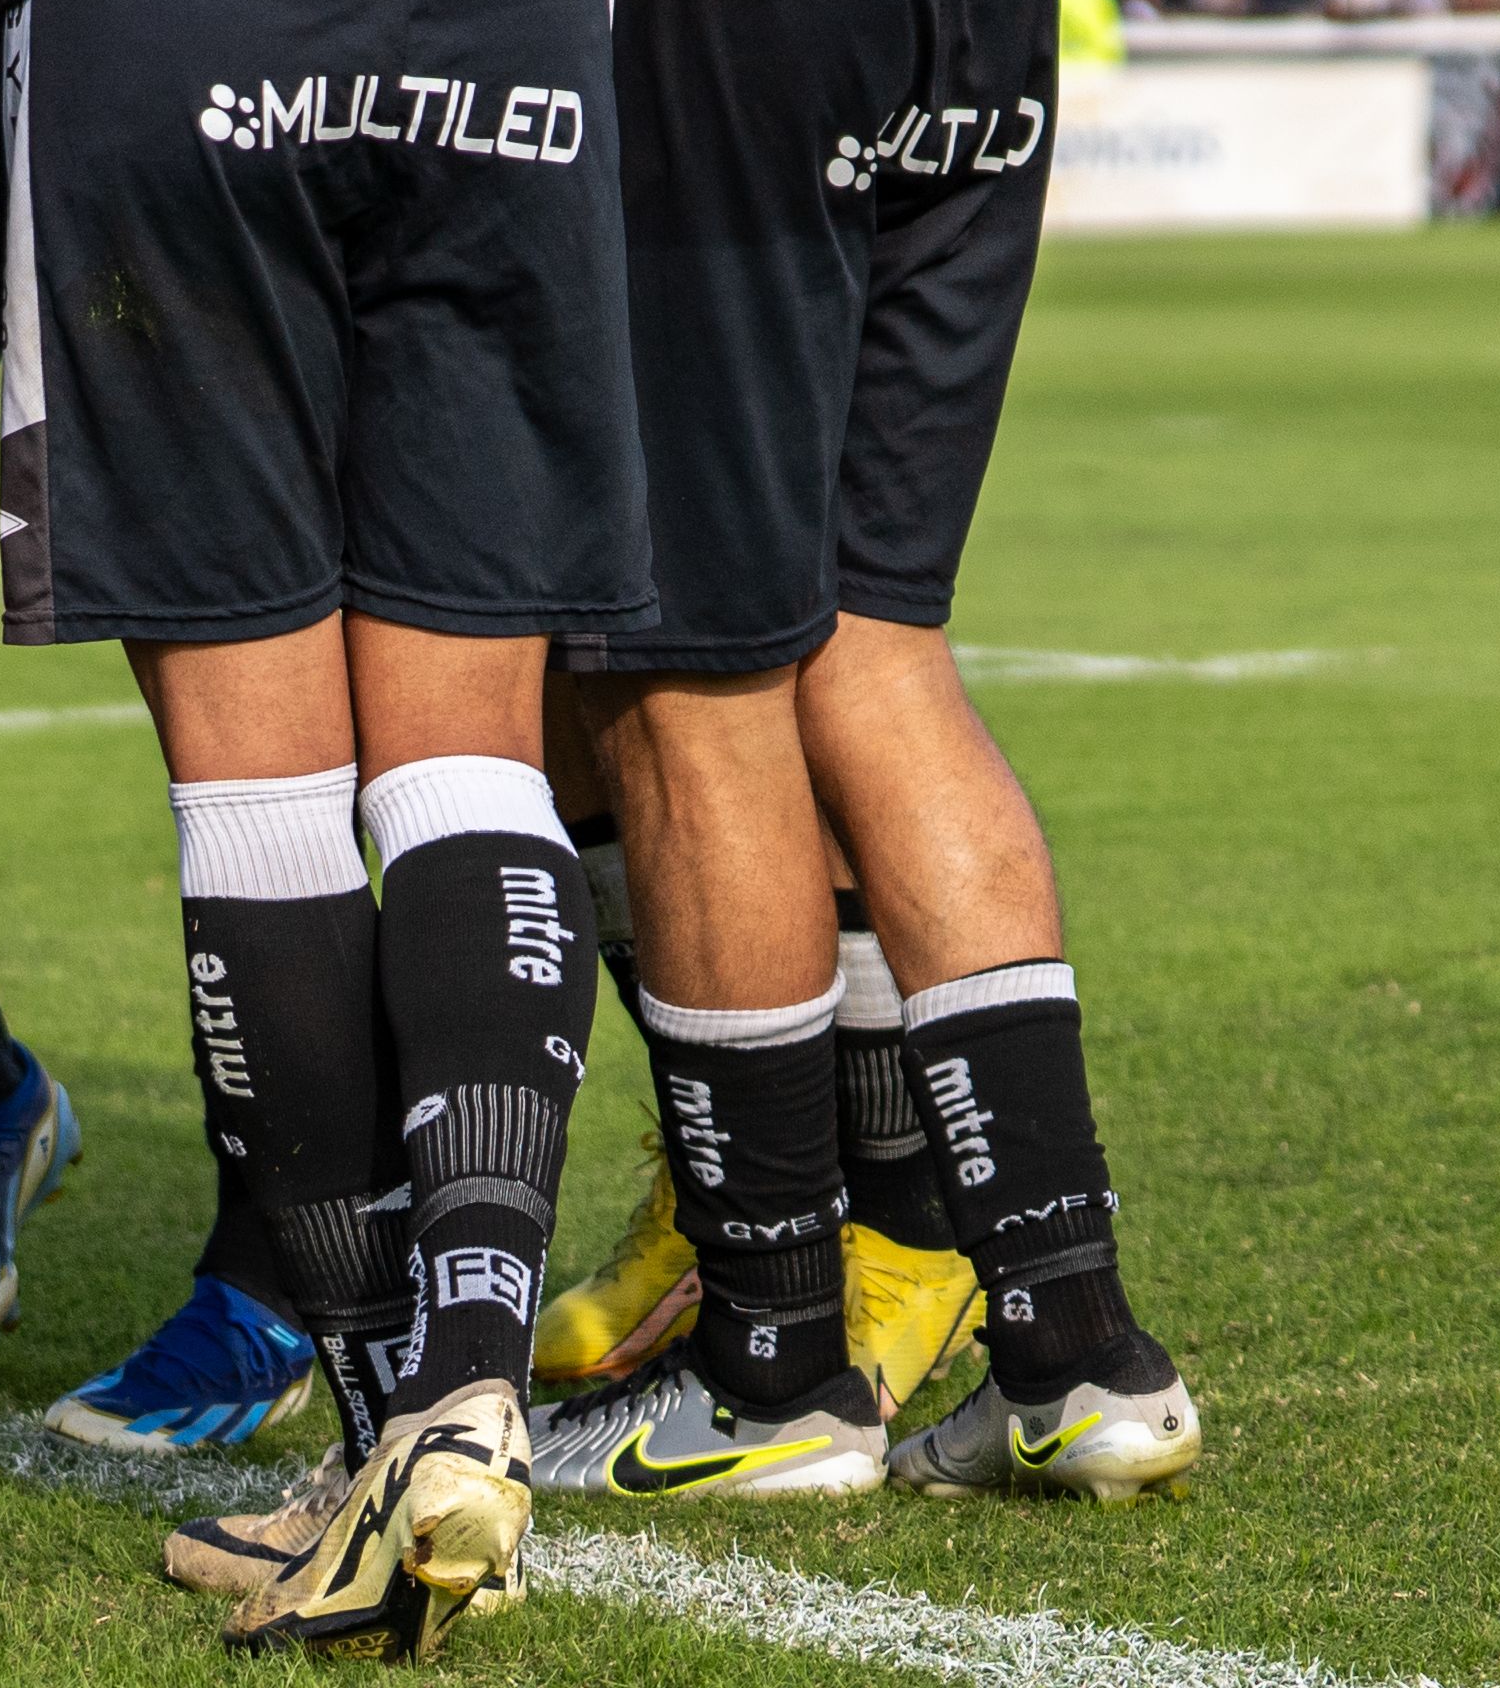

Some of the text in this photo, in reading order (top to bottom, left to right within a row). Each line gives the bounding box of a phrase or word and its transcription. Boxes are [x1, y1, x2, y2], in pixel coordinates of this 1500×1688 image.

[260, 75, 583, 164] MULTILED
[500, 866, 576, 988] mitre
[191, 951, 256, 1099] mitre
[669, 1073, 732, 1190] mitre
[926, 1055, 998, 1189] mitre
[448, 1253, 528, 1313] FS
